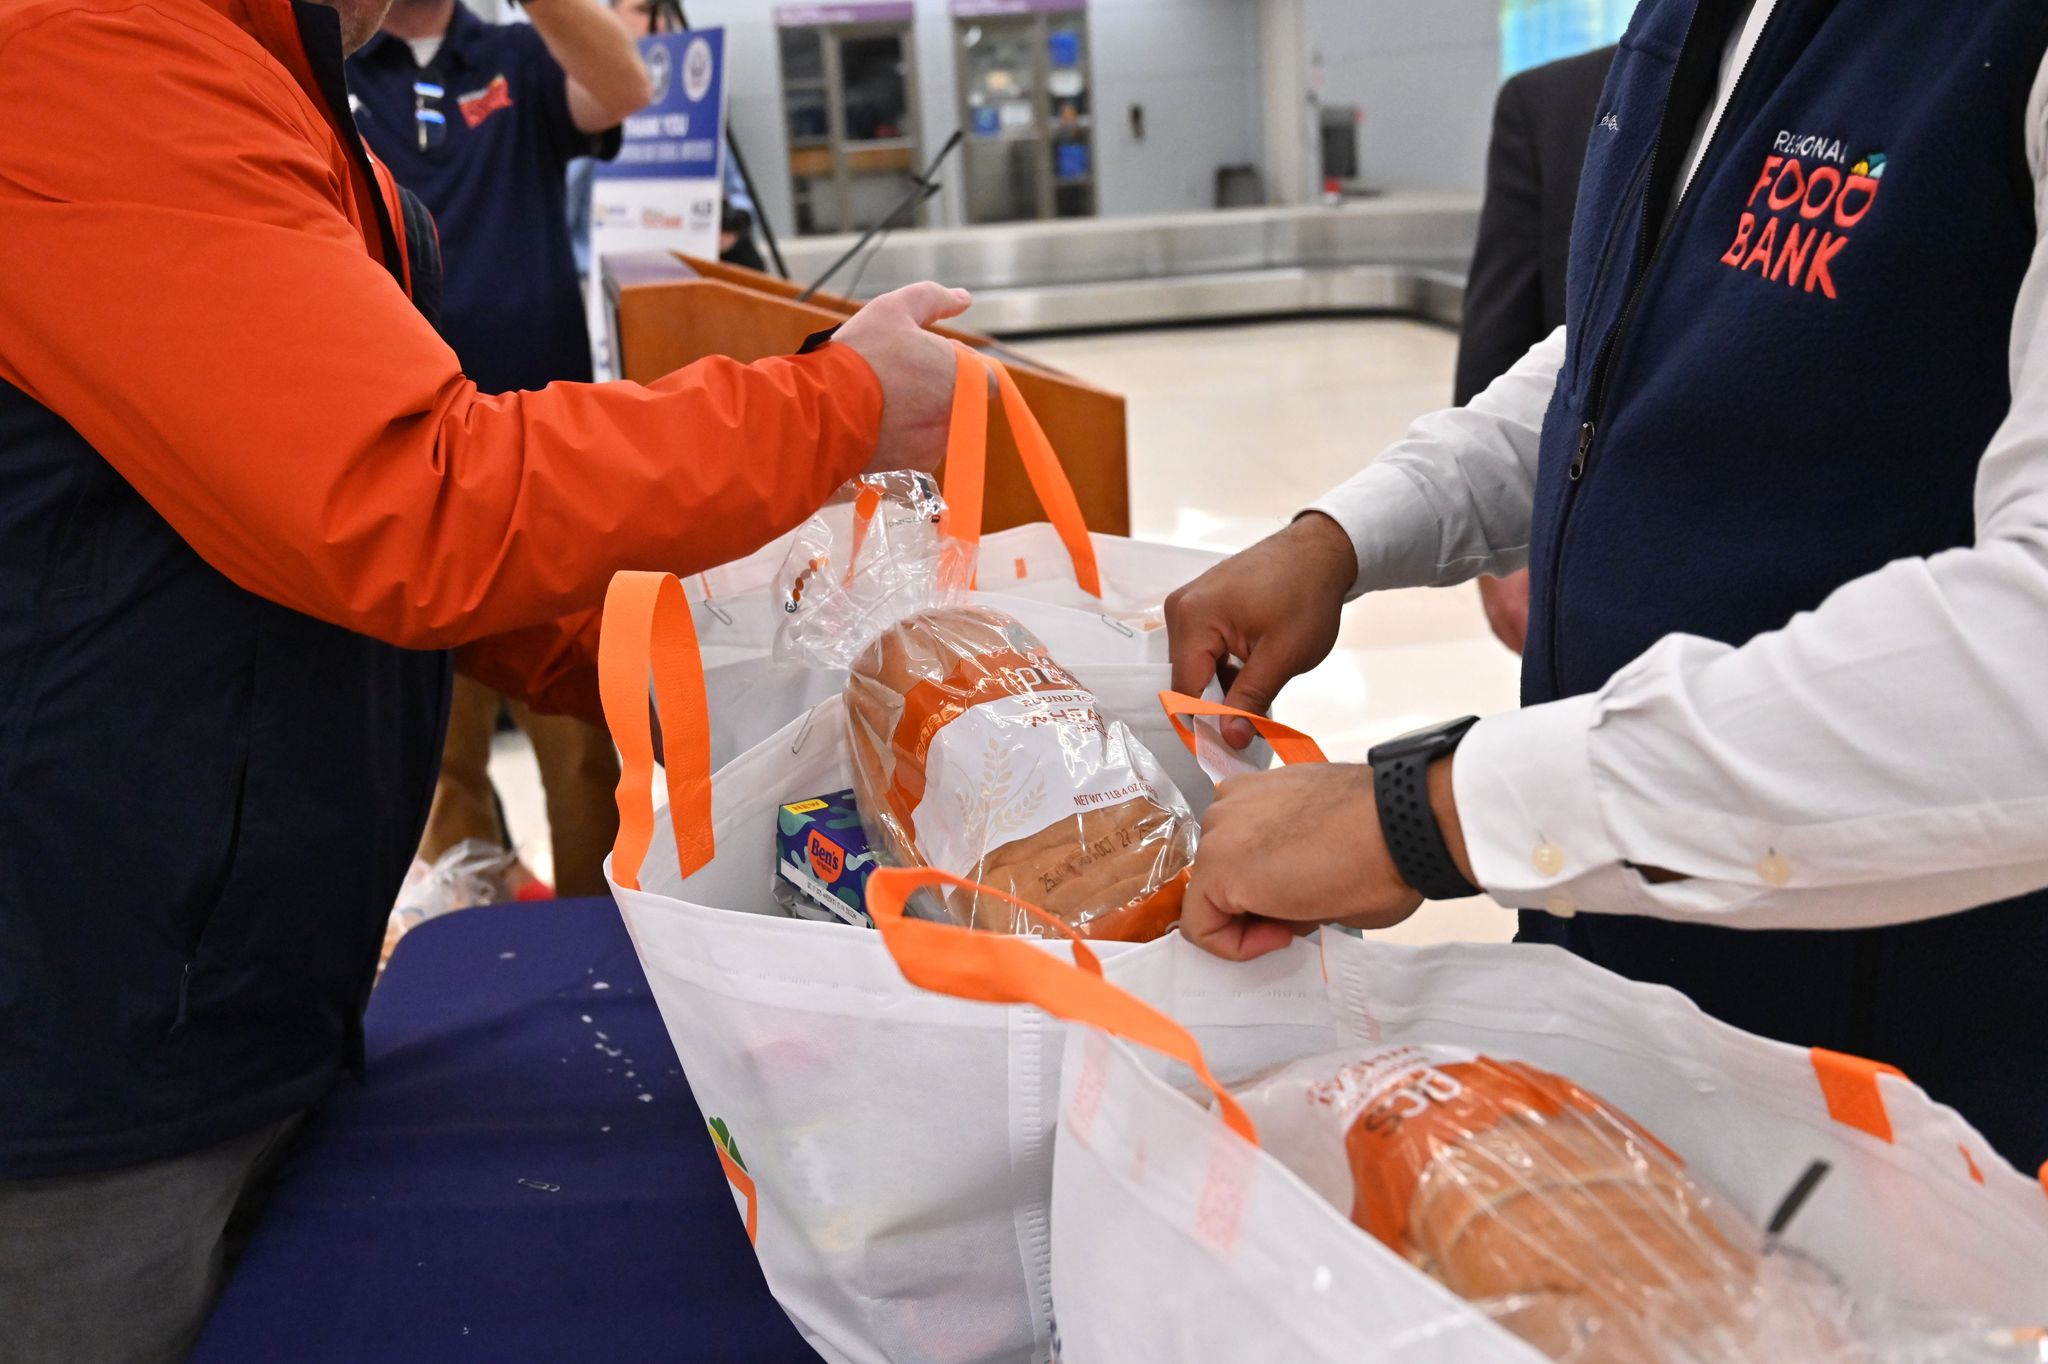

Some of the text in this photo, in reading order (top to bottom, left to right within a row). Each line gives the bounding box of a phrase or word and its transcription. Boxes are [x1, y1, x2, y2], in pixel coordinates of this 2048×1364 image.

[1747, 155, 1880, 228] FOOD
[1720, 211, 1848, 299] BANK
[1073, 793, 1090, 807] NET
[1089, 792, 1104, 804] WT
[1110, 789, 1122, 800] LB
[1121, 787, 1128, 796] 4
[1127, 783, 1140, 793] OZ
[811, 836, 840, 870] Ben's
